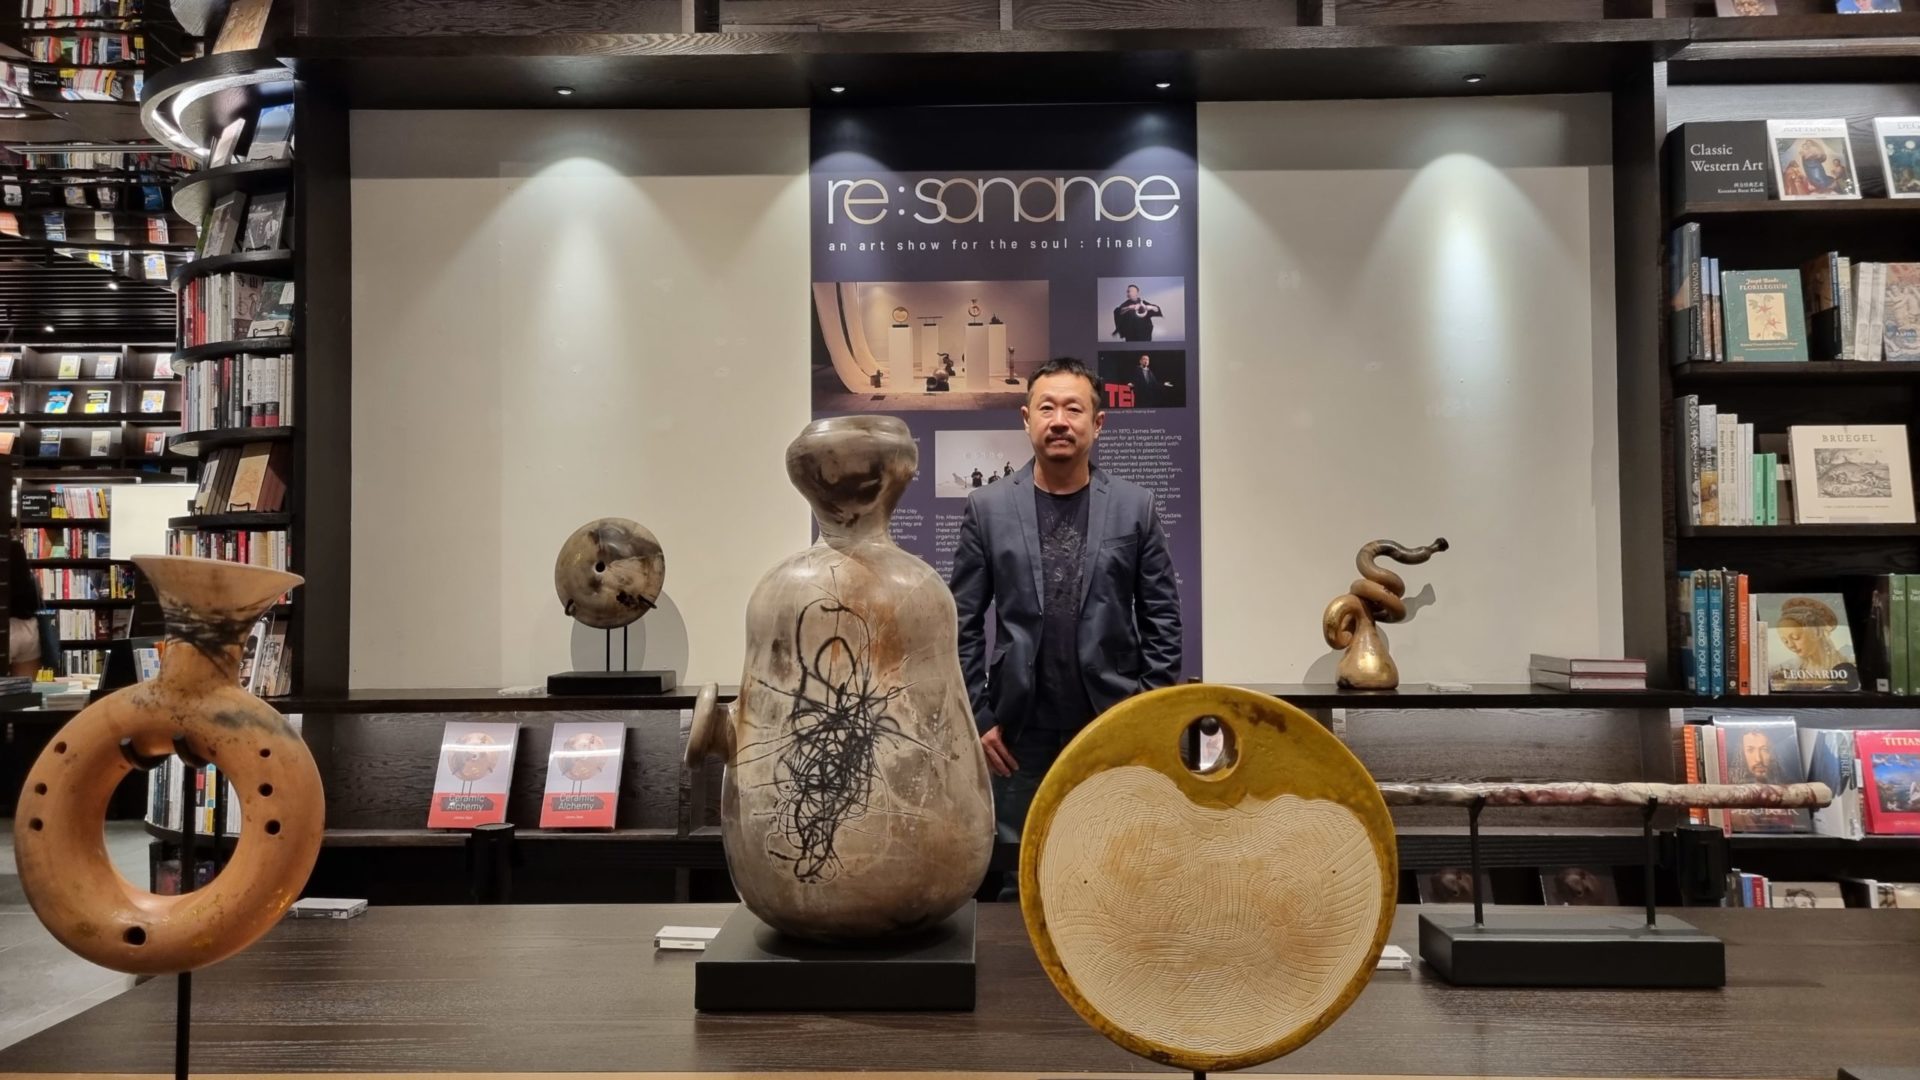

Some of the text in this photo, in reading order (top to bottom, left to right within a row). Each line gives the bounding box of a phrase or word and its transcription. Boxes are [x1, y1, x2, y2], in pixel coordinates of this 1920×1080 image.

[1690, 143, 1733, 156] Classic
[1690, 159, 1764, 172] Western Art
[828, 241, 848, 252] an
[859, 240, 886, 252] art
[896, 239, 941, 252] show
[952, 239, 978, 251] for
[990, 238, 1018, 250] the
[1030, 237, 1068, 249] soul
[1096, 236, 1154, 249] finale
[1104, 383, 1136, 408] TE
[1822, 434, 1877, 443] BRUEGEL
[1697, 608, 1706, 647] LEONARDO
[1712, 608, 1720, 647] LEONARDO
[1728, 627, 1735, 638] DA
[1782, 669, 1848, 680] LEONARDO
[448, 793, 485, 803] Ceramic
[559, 792, 595, 802] Ceramic
[447, 801, 484, 811] Alchemy
[558, 801, 594, 811] Alchemy
